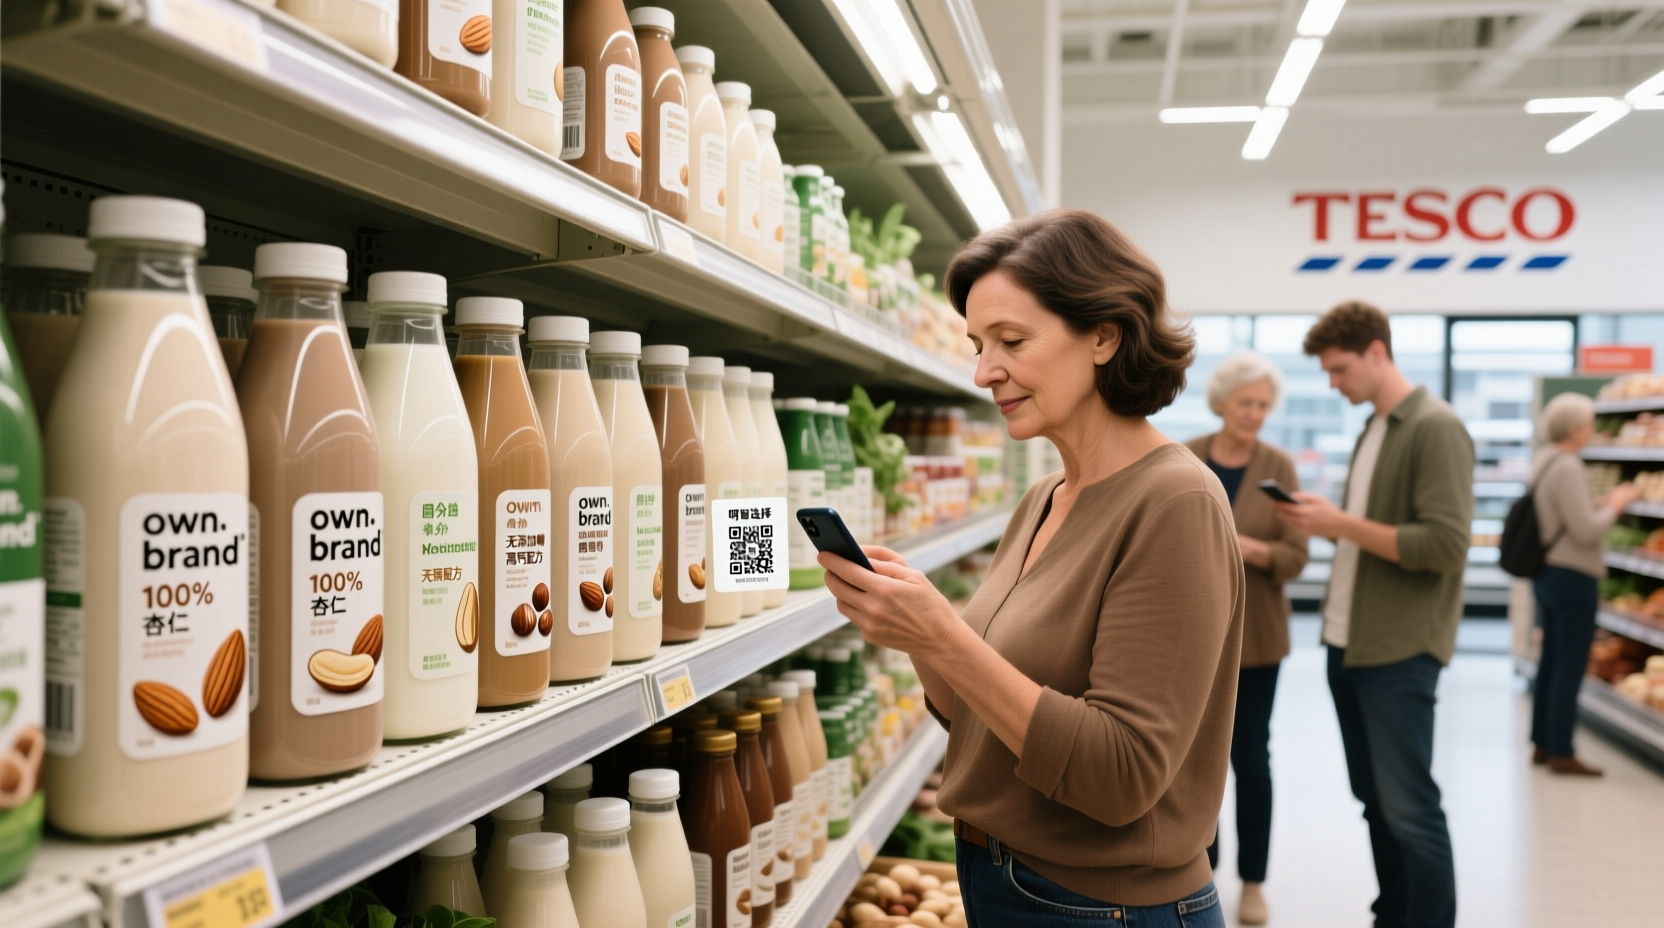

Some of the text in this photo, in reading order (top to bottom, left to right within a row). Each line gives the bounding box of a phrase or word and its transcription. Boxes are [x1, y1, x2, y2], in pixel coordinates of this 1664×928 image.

[1292, 187, 1577, 243] TESCO
[143, 512, 227, 536] own.
[310, 508, 376, 531] own.
[143, 535, 239, 570] brand
[310, 529, 381, 562] brand
[309, 571, 364, 594] 100%
[142, 582, 214, 610] 100%
[310, 595, 347, 617] 杏仁
[143, 612, 190, 637] 杏仁
